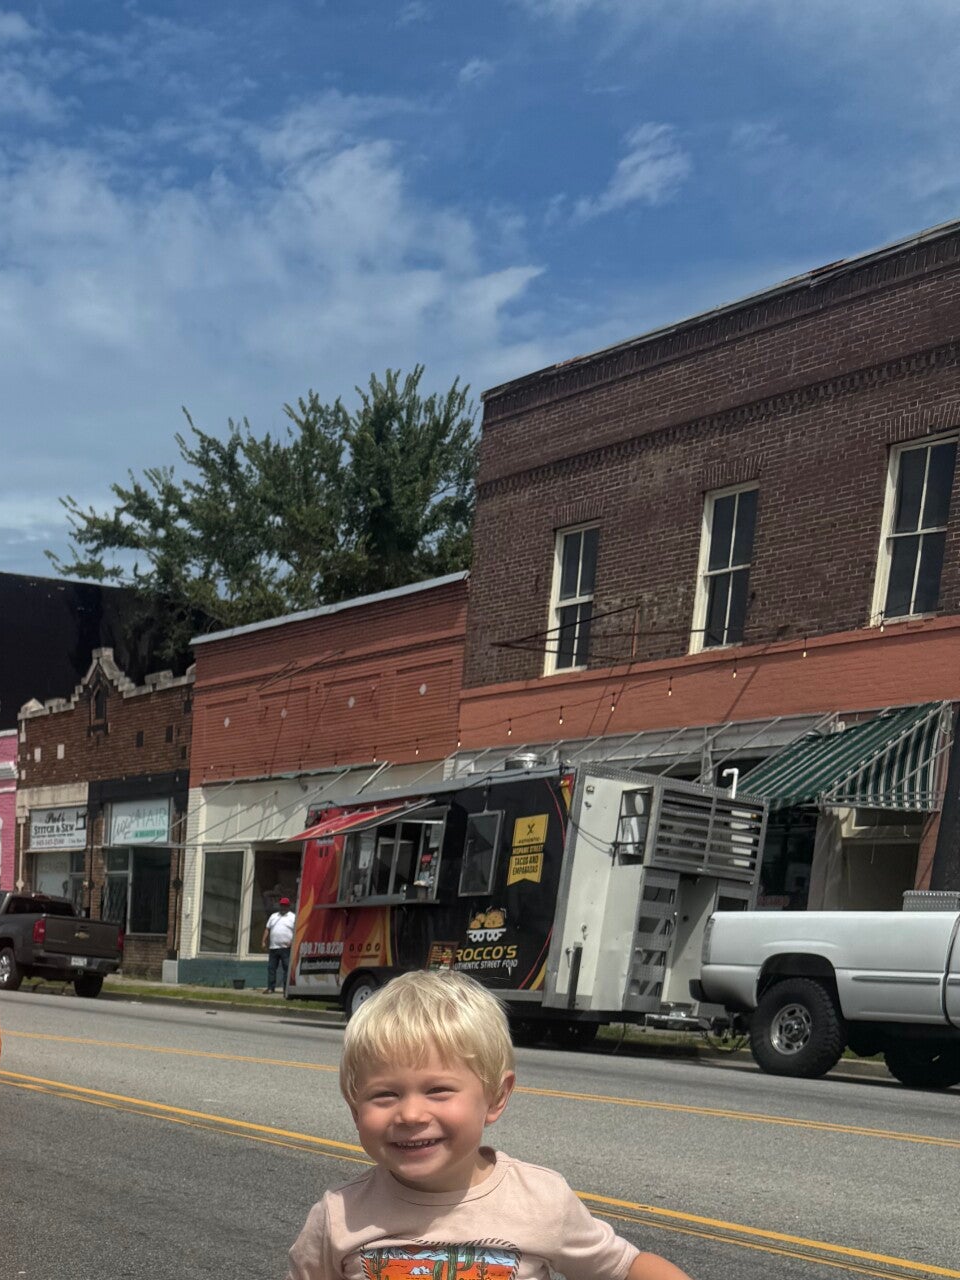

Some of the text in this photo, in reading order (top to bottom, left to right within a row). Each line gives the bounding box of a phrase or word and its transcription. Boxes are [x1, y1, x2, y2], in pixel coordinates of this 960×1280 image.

[34, 825, 54, 835] STITCH
[61, 823, 74, 832] SEW
[456, 945, 518, 962] ROCCO'S
[454, 959, 518, 970] UTHENTIC STREET FOOD
